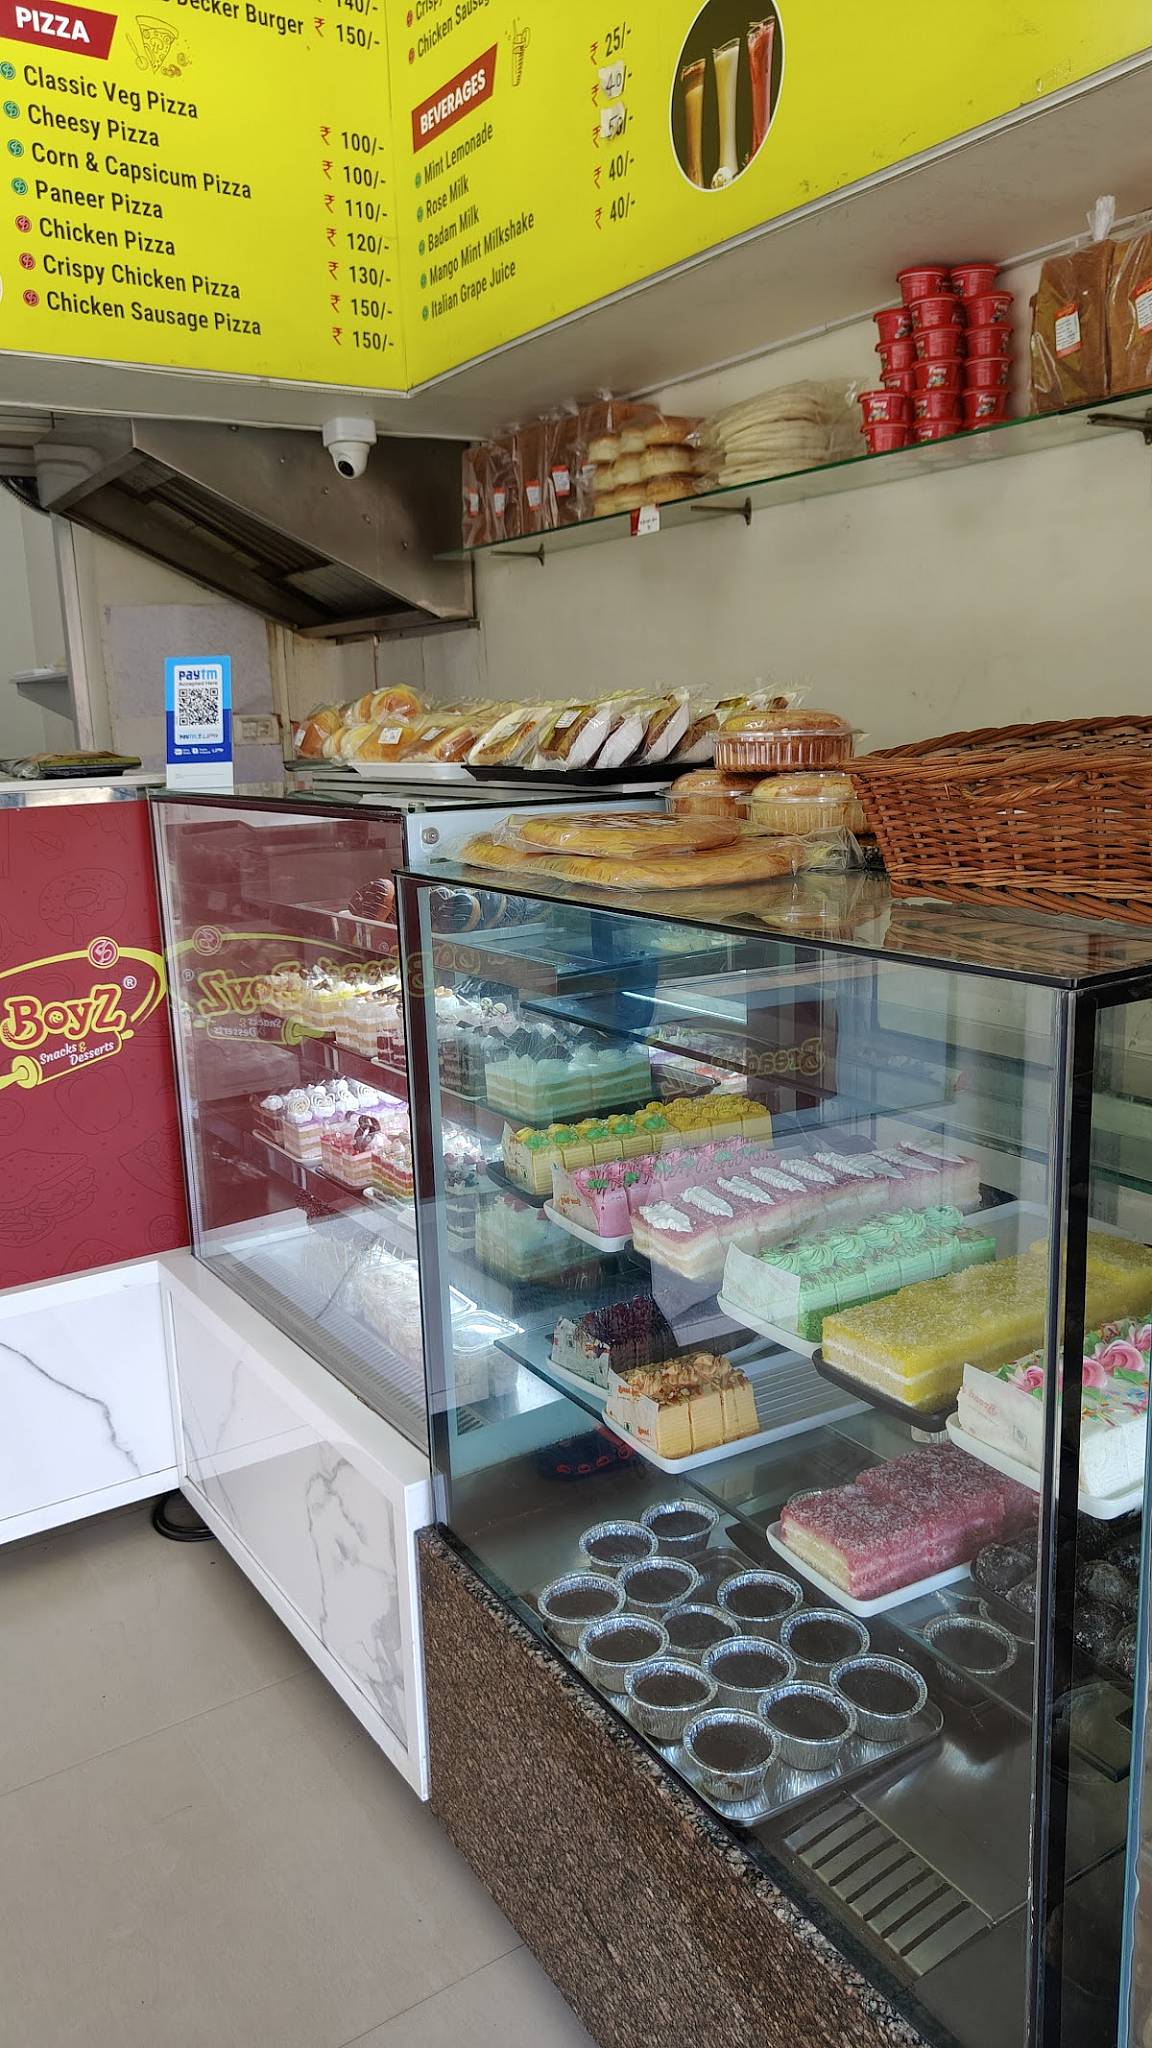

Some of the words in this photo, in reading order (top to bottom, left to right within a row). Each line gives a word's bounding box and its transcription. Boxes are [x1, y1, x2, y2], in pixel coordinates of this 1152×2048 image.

[15, 6, 90, 43] PIZZA
[246, 3, 304, 36] Burger
[336, 24, 380, 50] 150/-
[417, 16, 453, 57] Chicken
[605, 21, 631, 57] 25/-
[24, 65, 97, 98] Classic
[103, 81, 141, 112] Veg
[147, 90, 198, 119] Pizza
[420, 69, 486, 135] BEVERAGES
[28, 104, 100, 140] Cheesy
[108, 119, 160, 147] Pizza
[341, 131, 385, 156] 100/-
[32, 143, 78, 169] Corn
[86, 152, 99, 173] &
[105, 156, 197, 190] Capsicum
[204, 173, 252, 199] Pizza
[424, 156, 443, 184] Mint
[445, 122, 493, 173] Lemonade
[608, 151, 634, 181] 40/-
[343, 165, 387, 189] 100/-
[35, 180, 104, 209] Paneer
[112, 193, 163, 219] Pizza
[345, 199, 388, 222] 110/-
[426, 191, 447, 219] Rose
[449, 175, 469, 205] Milk
[610, 192, 636, 222] 40/-
[39, 218, 118, 247] Chicken
[125, 230, 175, 256] Pizza
[347, 232, 390, 255] 120/-
[427, 221, 457, 252] Badam
[459, 205, 479, 236] Milk
[429, 255, 459, 288] Mango
[461, 237, 482, 266] Mint
[484, 211, 534, 255] Milkshake
[43, 255, 105, 285] Crispy
[112, 264, 186, 293] Chicken
[192, 275, 240, 299] Pizza
[349, 265, 392, 288] 130/-
[431, 291, 458, 319] Italian
[461, 275, 487, 306] Grape
[490, 261, 516, 288] Juice
[47, 291, 125, 320] Chicken
[131, 302, 208, 332] Sausage
[214, 312, 261, 336] Pizza
[351, 298, 393, 320] 150/-
[353, 331, 394, 352] 150/-
[40, 1043, 77, 1065] Snacks
[79, 1042, 86, 1052] &
[69, 1042, 114, 1066] Desserts
